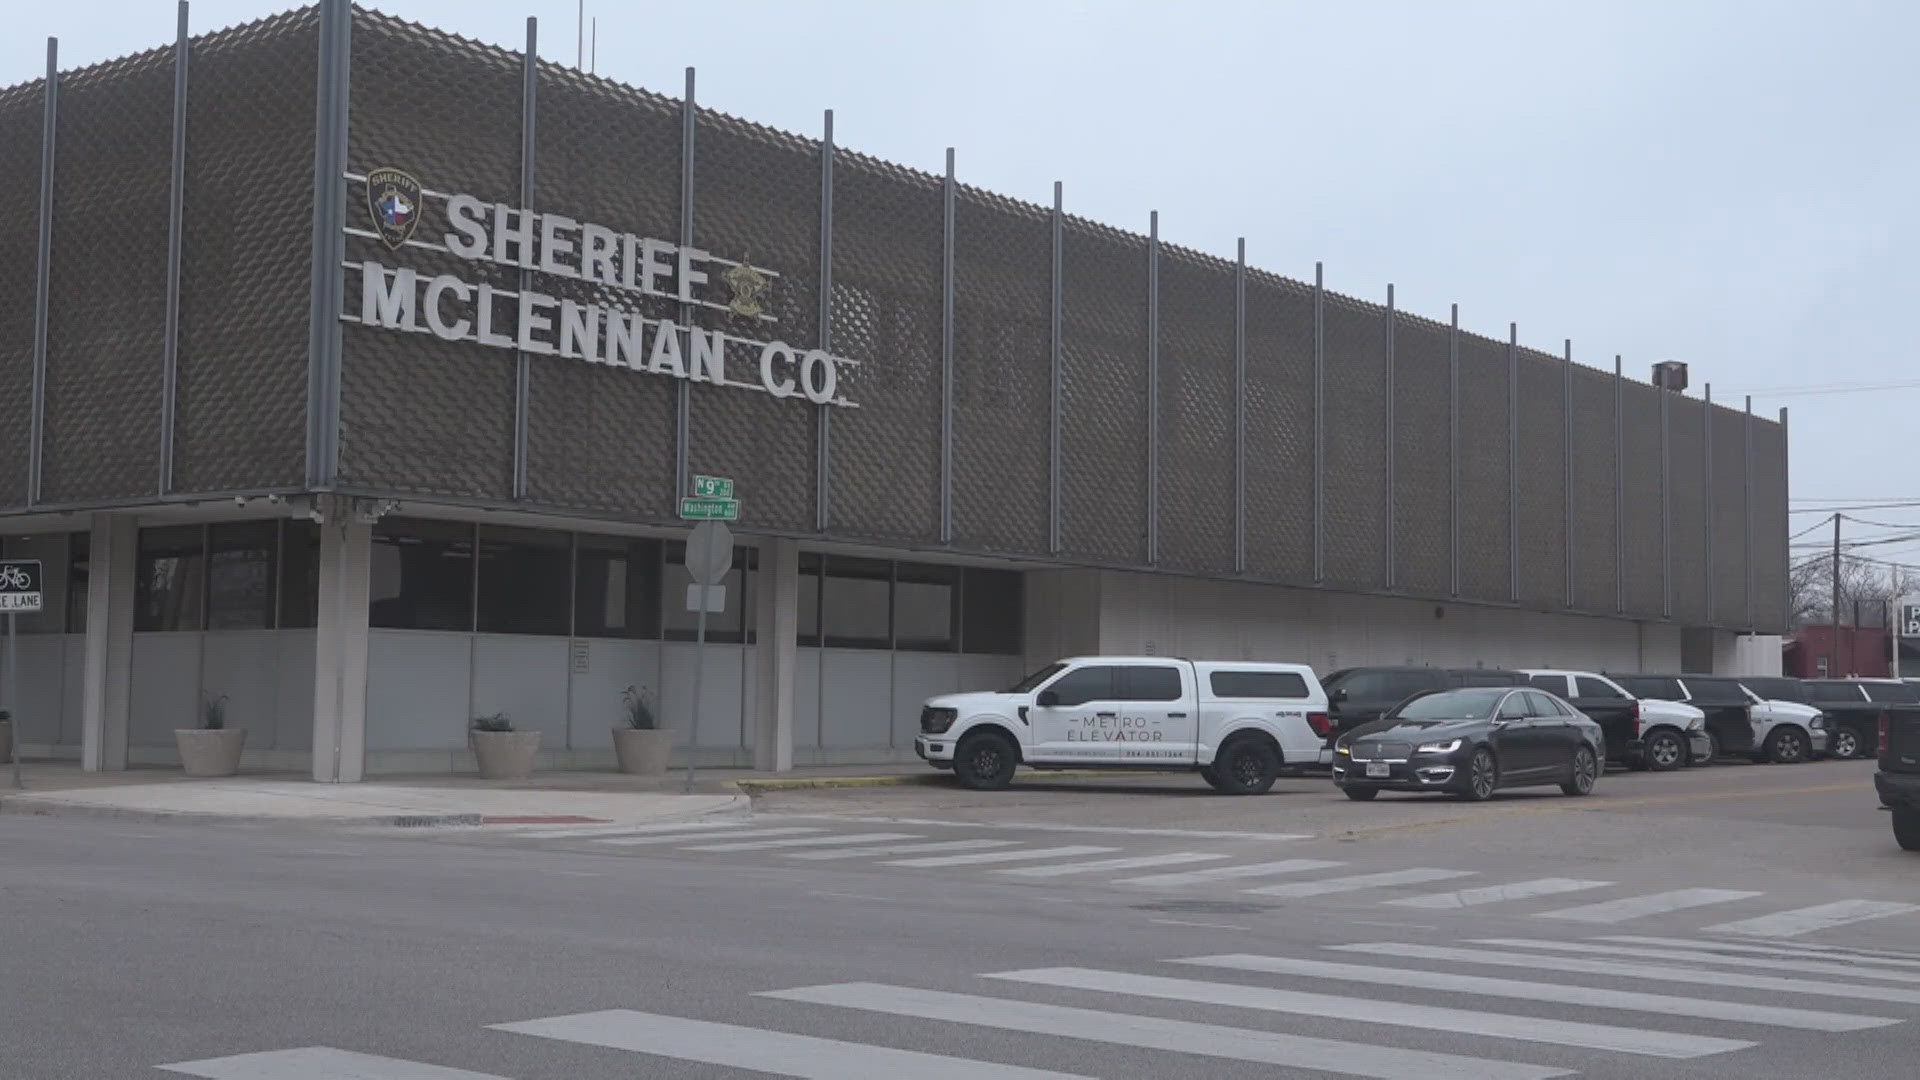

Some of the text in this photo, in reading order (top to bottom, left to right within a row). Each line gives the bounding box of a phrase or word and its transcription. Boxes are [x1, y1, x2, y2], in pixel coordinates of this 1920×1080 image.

[445, 194, 711, 302] SHERIFF
[362, 261, 725, 386] MCLENNAN
[698, 479, 704, 489] N
[684, 502, 723, 517] Washington
[14, 595, 39, 607] LANE
[1083, 716, 1147, 729] METRO
[1067, 730, 1163, 742] ELEVATOR
